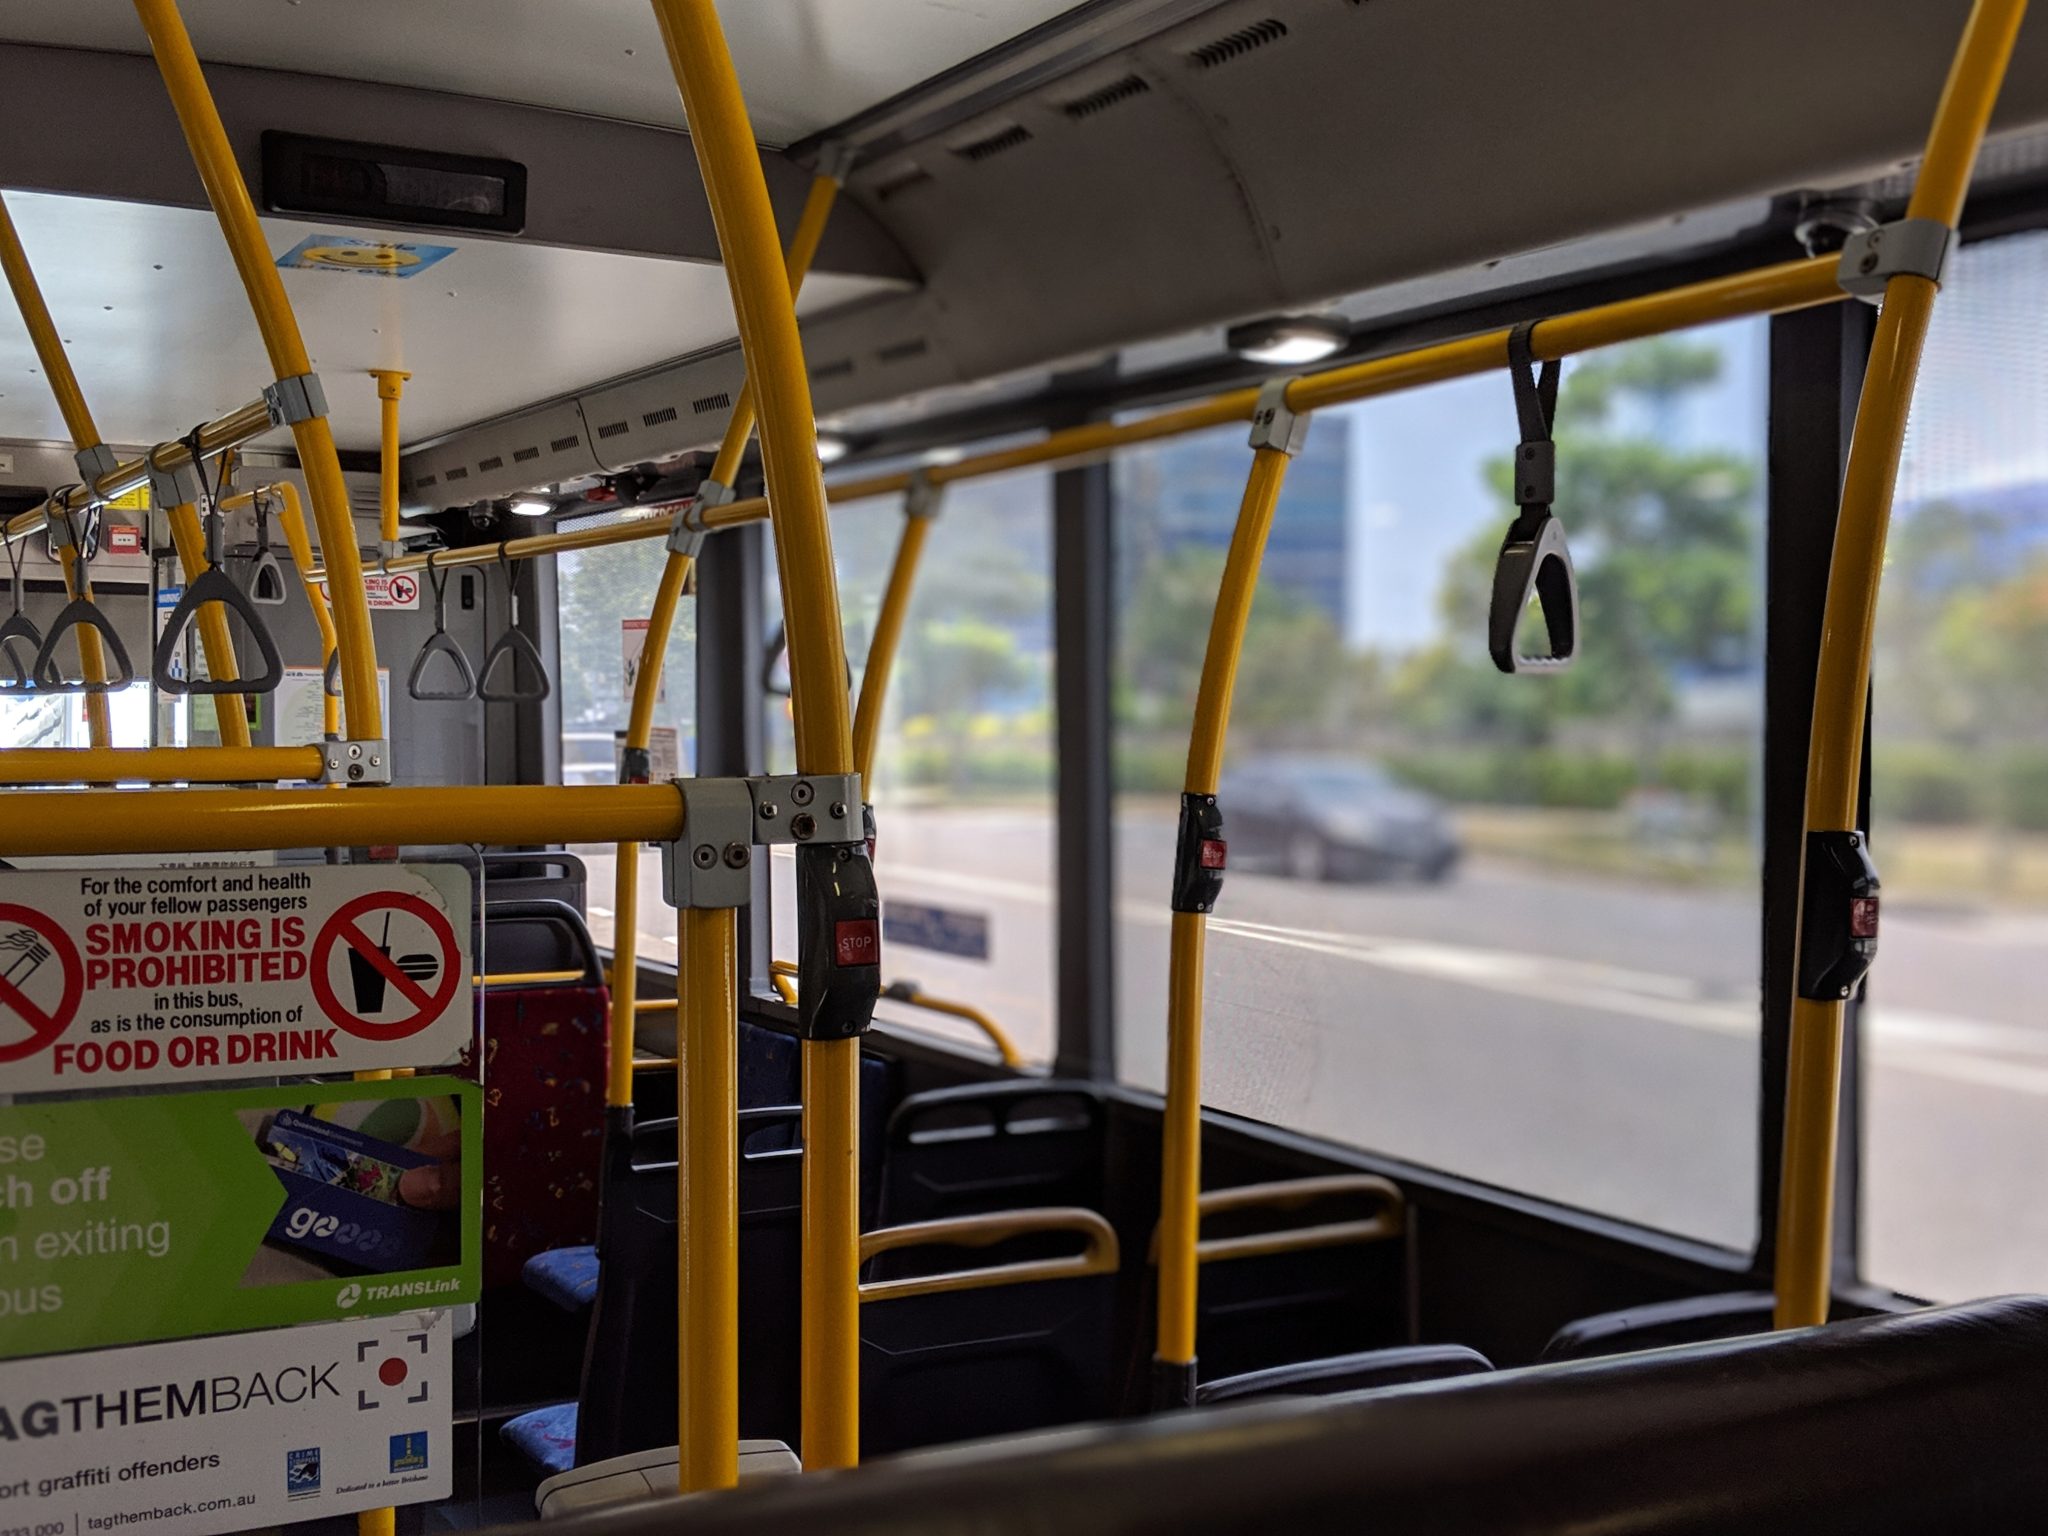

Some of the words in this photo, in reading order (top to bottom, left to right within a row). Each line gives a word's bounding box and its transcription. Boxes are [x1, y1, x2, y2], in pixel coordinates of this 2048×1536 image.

[81, 877, 109, 895] For
[114, 876, 142, 894] the
[147, 874, 217, 894] comfort
[222, 873, 253, 892] and
[259, 872, 311, 891] health
[84, 898, 102, 917] of
[108, 900, 147, 919] your
[151, 895, 202, 915] fellow
[207, 896, 307, 916] passengers
[86, 918, 261, 956] SMOKING
[272, 916, 305, 948] IS
[842, 936, 872, 950] STOP
[86, 951, 307, 990] PROHIBITED
[155, 993, 169, 1010] in
[173, 991, 204, 1009] this
[208, 990, 243, 1009] bus,
[91, 1019, 108, 1034] as
[112, 1015, 132, 1032] is
[136, 1014, 165, 1031] the
[170, 1008, 281, 1029] consumption
[286, 1005, 303, 1023] of
[54, 1040, 159, 1074] FOOD
[168, 1036, 219, 1068] OR
[227, 1029, 338, 1062] DRINK
[50, 1166, 112, 1205] off
[36, 1221, 170, 1258] exiting
[38, 1466, 111, 1498] graffiti
[118, 1454, 220, 1482] offenders
[88, 1493, 256, 1530] tagthemback.com.au
